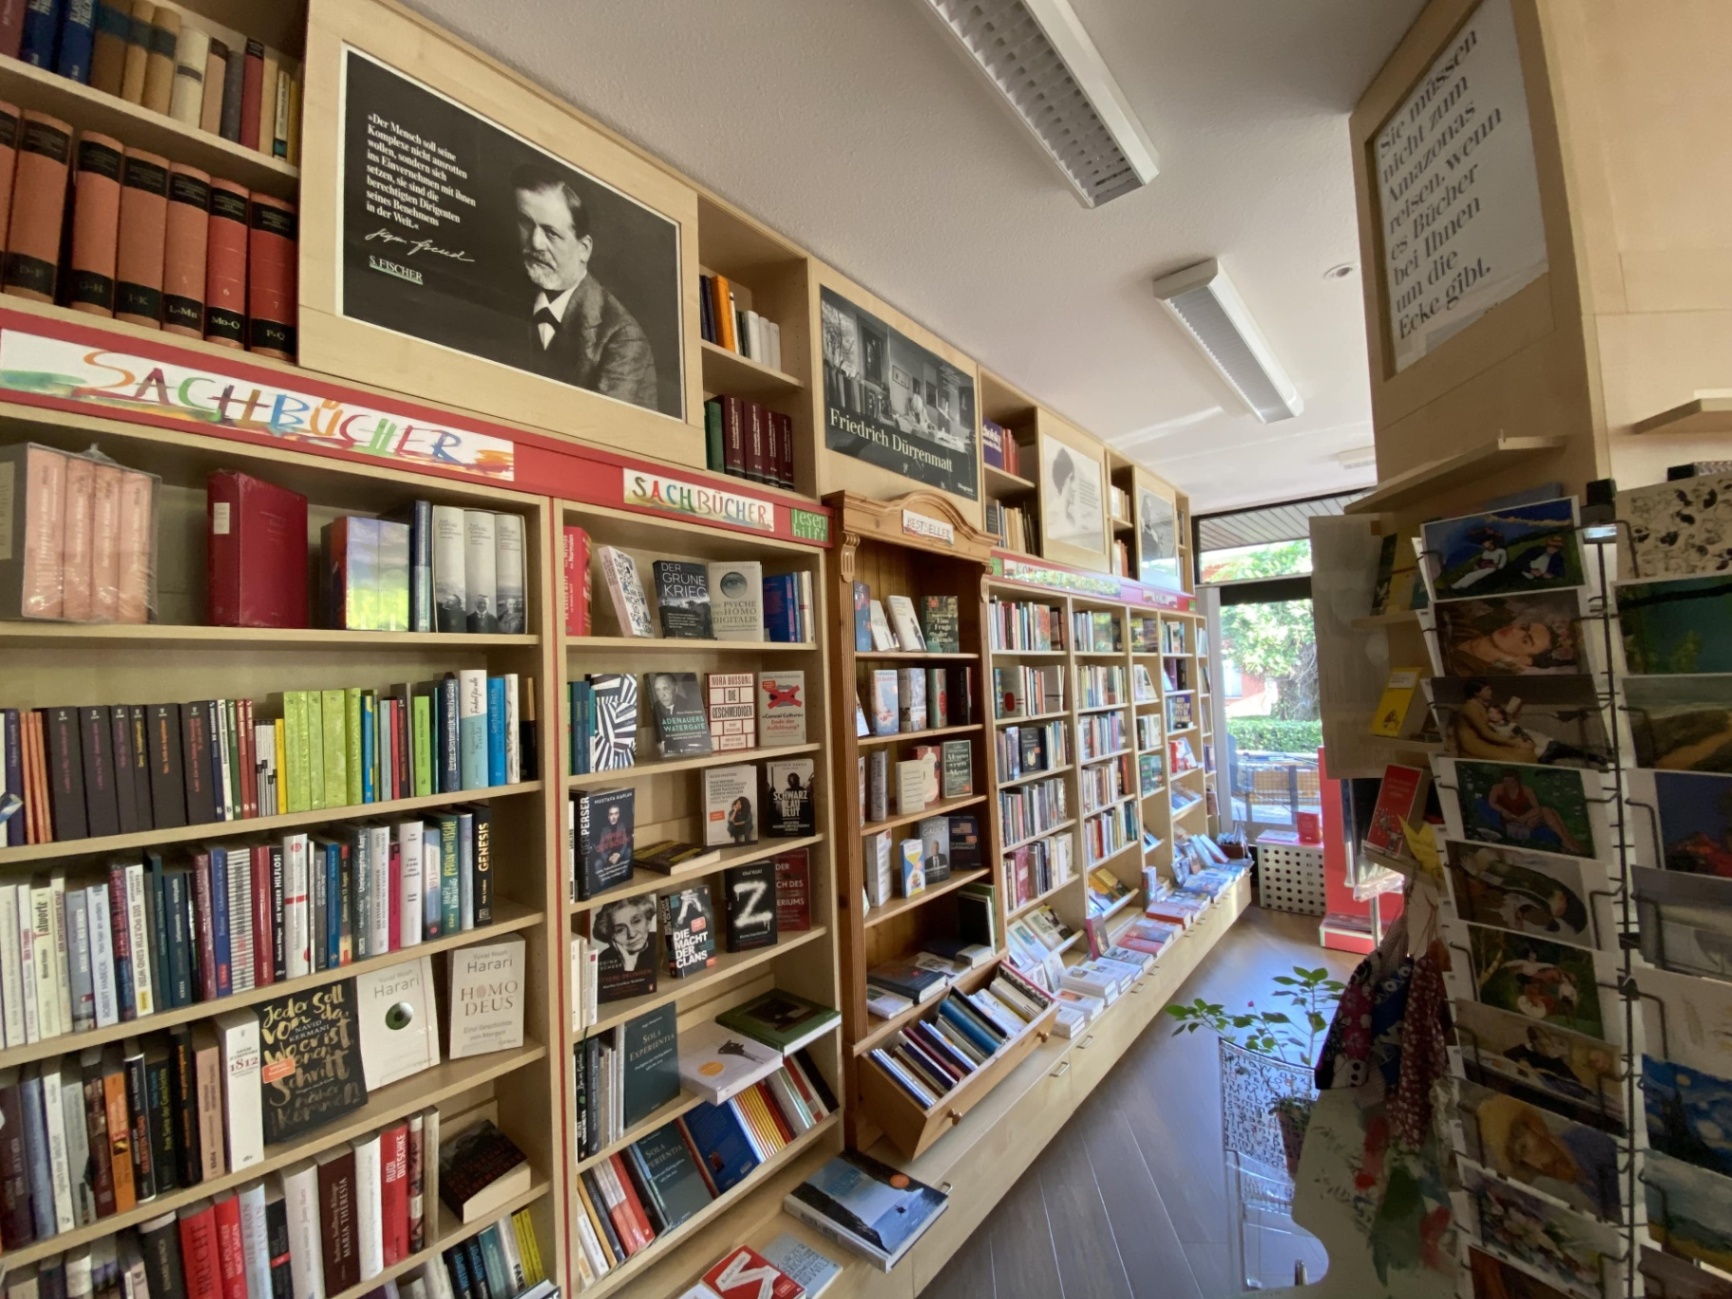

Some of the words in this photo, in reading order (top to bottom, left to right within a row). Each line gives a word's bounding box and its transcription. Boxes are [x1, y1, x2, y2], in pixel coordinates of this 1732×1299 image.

[1380, 121, 1404, 159] Sie
[1409, 27, 1480, 122] müssen
[368, 113, 389, 128] »Der
[390, 121, 422, 146] Mensch
[423, 136, 436, 152] soll
[437, 145, 457, 162] seine
[1383, 126, 1426, 184] nicht
[1429, 75, 1469, 134] zum
[1446, 106, 1503, 171] wenn
[367, 124, 410, 152] Komplexe
[411, 142, 431, 161] nicht
[432, 153, 468, 179] ausrotten
[367, 139, 397, 159] wollen,
[398, 152, 431, 174] sondern
[431, 164, 447, 181] sich
[1388, 100, 1477, 204] Amazonas
[366, 164, 395, 185] setzen,
[396, 175, 408, 189] sie
[409, 181, 426, 197] sind
[426, 188, 440, 202] die
[367, 150, 380, 163] ins
[381, 155, 440, 191] Einvernehmen
[441, 183, 454, 197] mit
[455, 190, 477, 207] ihnen
[366, 175, 418, 206] berechtigten
[419, 198, 461, 223] Dirigenten
[366, 190, 392, 207] seines
[393, 200, 440, 226] Benehmens
[1391, 236, 1408, 262] es
[1413, 163, 1479, 243] Bücher
[366, 201, 375, 213] in
[376, 205, 391, 219] der
[393, 212, 420, 230] Welt.«
[1393, 255, 1421, 288] bei
[1424, 196, 1481, 259] Ihnen
[369, 255, 379, 266] S.
[379, 259, 423, 282] FISCHER
[1395, 280, 1424, 315] um
[1427, 251, 1459, 285] die
[1399, 292, 1440, 341] Ecke
[1446, 255, 1492, 311] gibt.
[83, 350, 462, 463] SACHBÜCHER
[829, 407, 890, 448] Friedrich
[892, 433, 954, 473] Dürrenmatt
[632, 475, 768, 526] SACHBÜCHER
[793, 510, 827, 530] lesen
[906, 515, 952, 539] BESTSELLER
[661, 562, 682, 573] DER
[662, 571, 706, 587] GRÜNE
[663, 584, 708, 600] KRIEG
[723, 600, 757, 608] PSYCHE
[712, 615, 758, 624] DIGITALIS
[724, 608, 757, 616] HOMO
[727, 689, 737, 702] DIE
[662, 715, 705, 726] ADENAUERS
[663, 722, 706, 733] WATERGATE
[773, 789, 808, 801] SCHWARZ
[579, 796, 590, 837] PERSER
[922, 826, 947, 836] GAUCK
[478, 822, 489, 872] GENESIS
[273, 854, 282, 888] HILFLOS!
[775, 863, 790, 871] DER
[429, 872, 438, 890] 1913
[734, 881, 773, 931] Z
[673, 929, 691, 942] DIE
[674, 931, 708, 950] MACHT
[467, 956, 514, 975] Harari
[675, 947, 695, 960] DER
[676, 951, 708, 969] CLANS
[98, 960, 108, 990] HABECK
[373, 976, 421, 999] Harari
[460, 980, 519, 1002] HOMO
[262, 999, 309, 1028] Jeder
[464, 998, 514, 1017] DEUS
[289, 1025, 331, 1042] KERMANI
[294, 1020, 323, 1034] NAVID
[479, 1020, 513, 1033] Geschichte
[642, 1030, 662, 1044] SOLA
[629, 1033, 675, 1061] EXPERIENTIA
[230, 1057, 258, 1073] 1812
[395, 1134, 406, 1179] DUTSCHKE
[645, 1143, 666, 1159] SOLA
[385, 1161, 396, 1183] RUDI
[339, 1177, 351, 1225] THERESIA
[221, 1224, 232, 1264] POLITIKER
[232, 1223, 242, 1251] SAGEN
[341, 1225, 352, 1258] MARIA
[191, 1225, 213, 1297] BRECHT
[235, 1251, 244, 1275] NICHT
